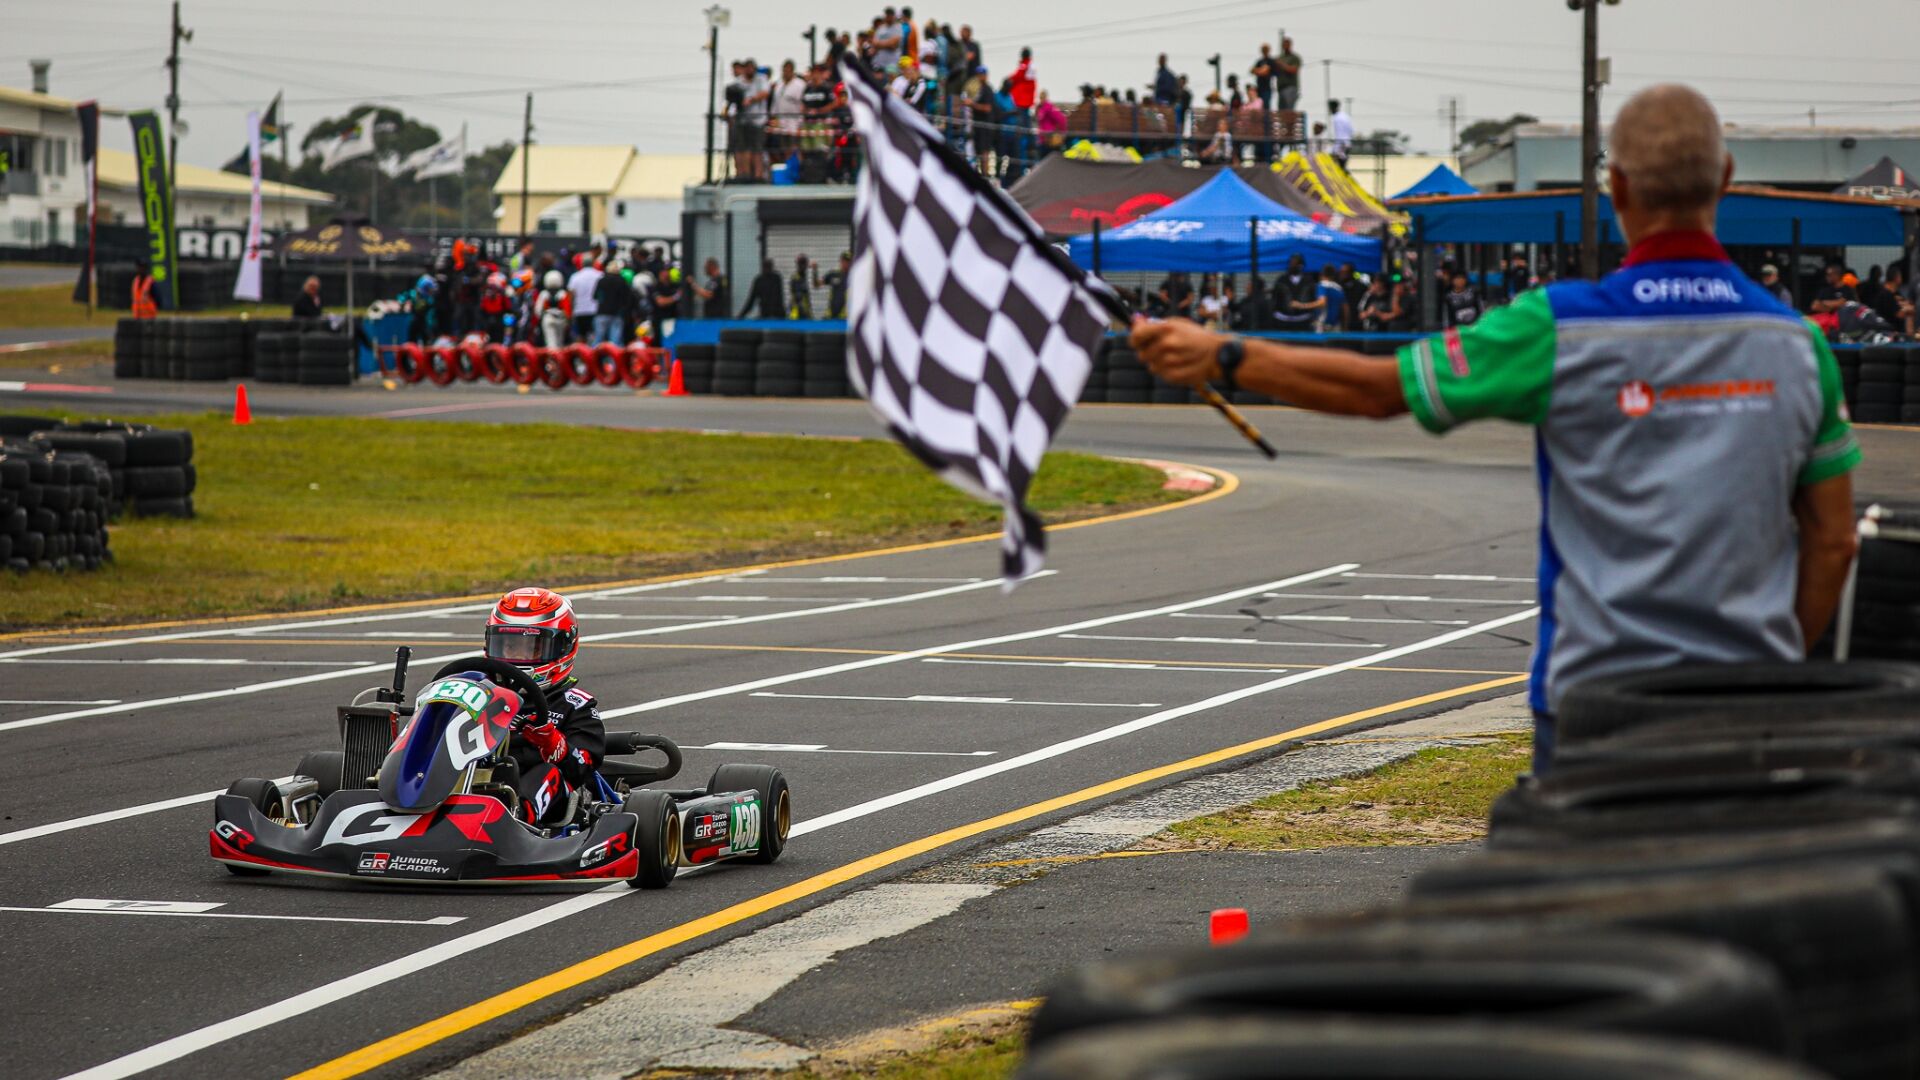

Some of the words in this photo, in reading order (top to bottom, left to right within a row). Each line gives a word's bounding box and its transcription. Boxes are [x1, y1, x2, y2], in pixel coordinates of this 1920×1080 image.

[1633, 277, 1743, 303] OFFICIAL
[216, 820, 255, 850] GR
[312, 794, 507, 850] GR
[695, 824, 712, 838] GR
[732, 802, 760, 850] 430
[390, 855, 439, 866] JUNIOR
[580, 831, 628, 867] GR
[359, 859, 387, 869] GR
[388, 862, 450, 874] ACADEMY
